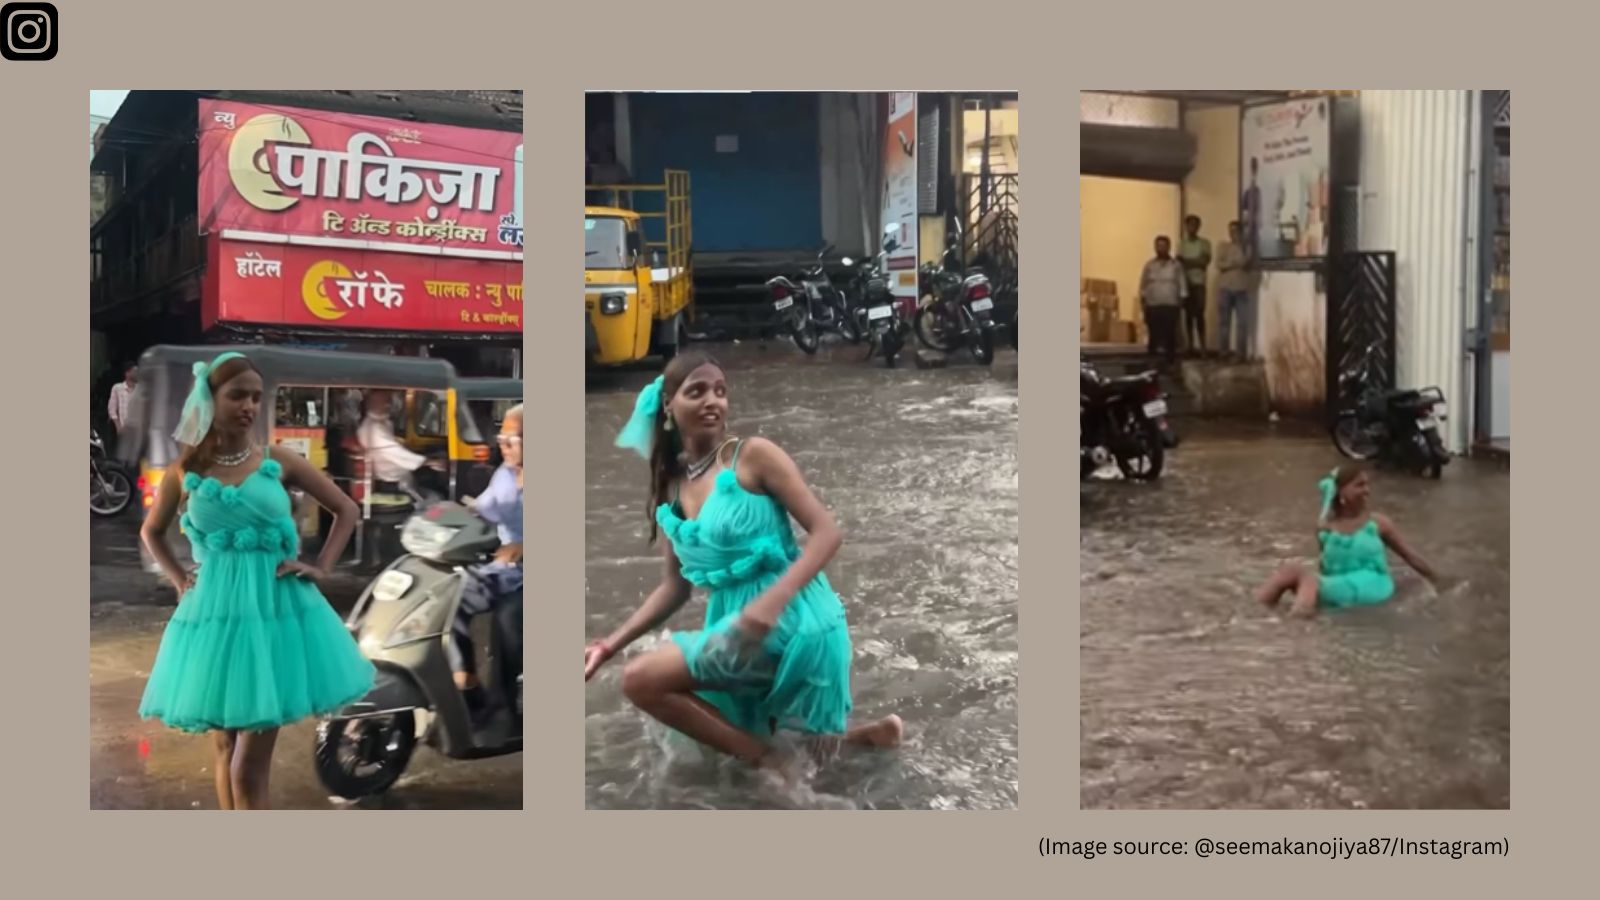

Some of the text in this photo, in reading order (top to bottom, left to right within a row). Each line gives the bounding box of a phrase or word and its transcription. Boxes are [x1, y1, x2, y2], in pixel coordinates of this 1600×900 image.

[323, 210, 343, 231] टि
[235, 252, 282, 278] हॉटेल
[423, 280, 471, 297] चालक
